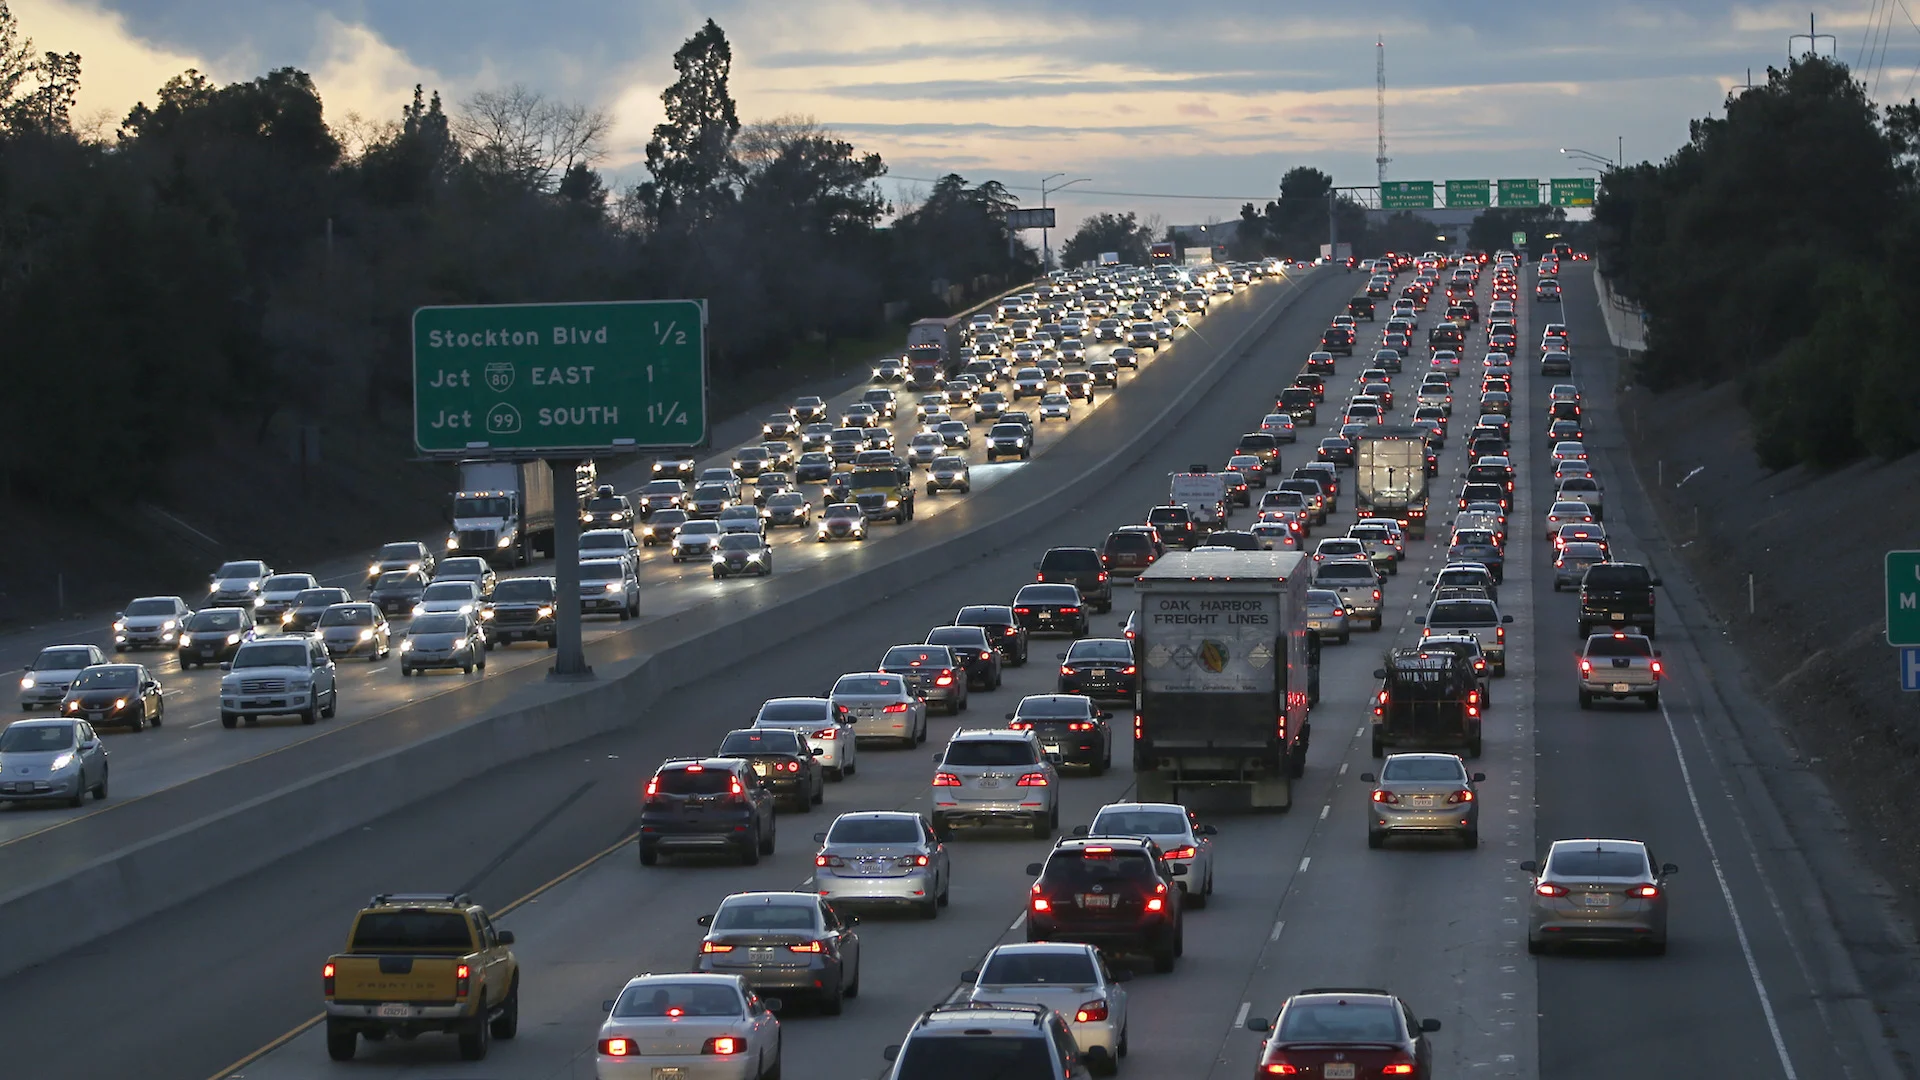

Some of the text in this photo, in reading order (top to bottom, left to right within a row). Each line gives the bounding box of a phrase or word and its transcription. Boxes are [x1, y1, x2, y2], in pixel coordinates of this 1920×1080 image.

[429, 320, 687, 348] Stockton Blvd 1/2
[430, 364, 654, 388] Jct 80 EAST 1
[431, 409, 472, 429] Jct
[493, 414, 514, 429] 99
[538, 405, 619, 427] SOUTH
[1159, 600, 1263, 611] OAK HARBOR
[1154, 614, 1269, 625] FREIGHT LINES
